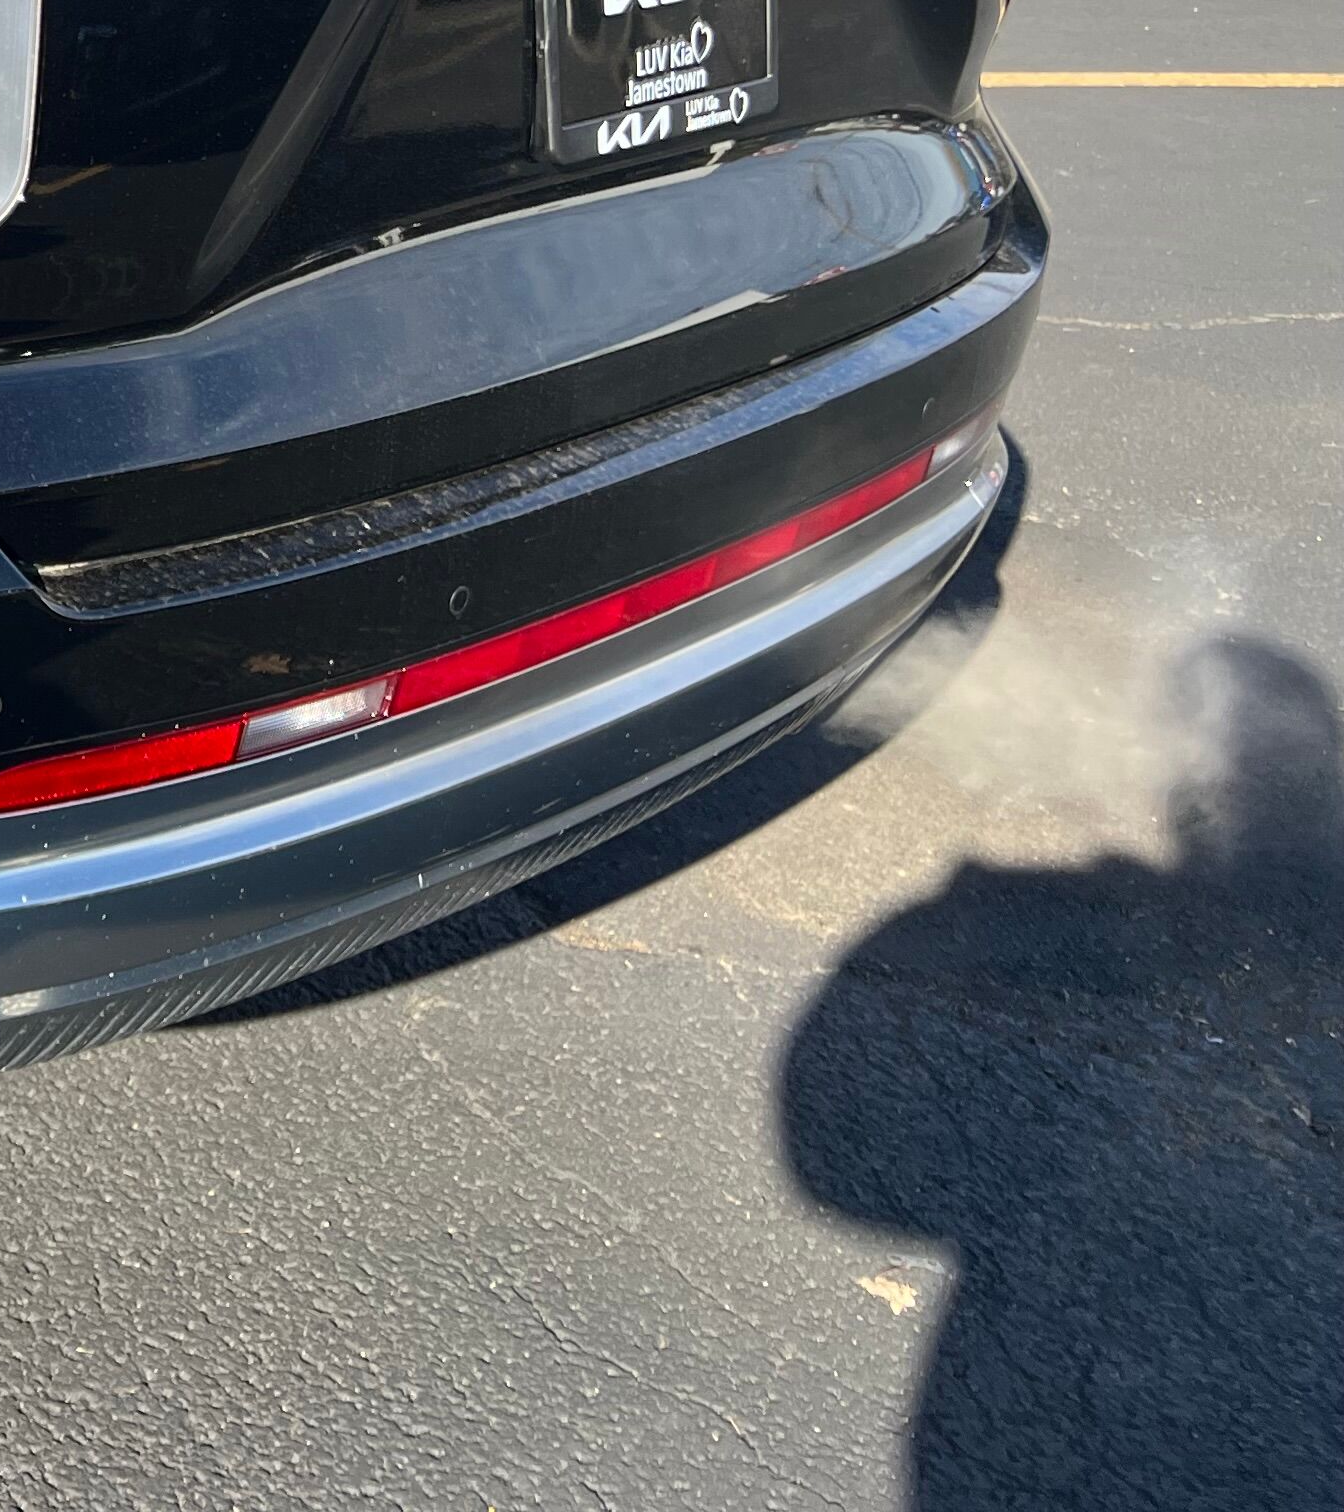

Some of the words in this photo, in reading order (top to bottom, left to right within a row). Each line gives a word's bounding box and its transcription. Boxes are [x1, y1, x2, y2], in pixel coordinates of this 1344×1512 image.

[636, 43, 669, 77] LUV
[670, 39, 693, 69] Kia
[625, 66, 708, 108] Jamestown
[685, 97, 704, 117] LUV
[685, 109, 732, 133] Jamestown
[597, 104, 672, 155] KIA
